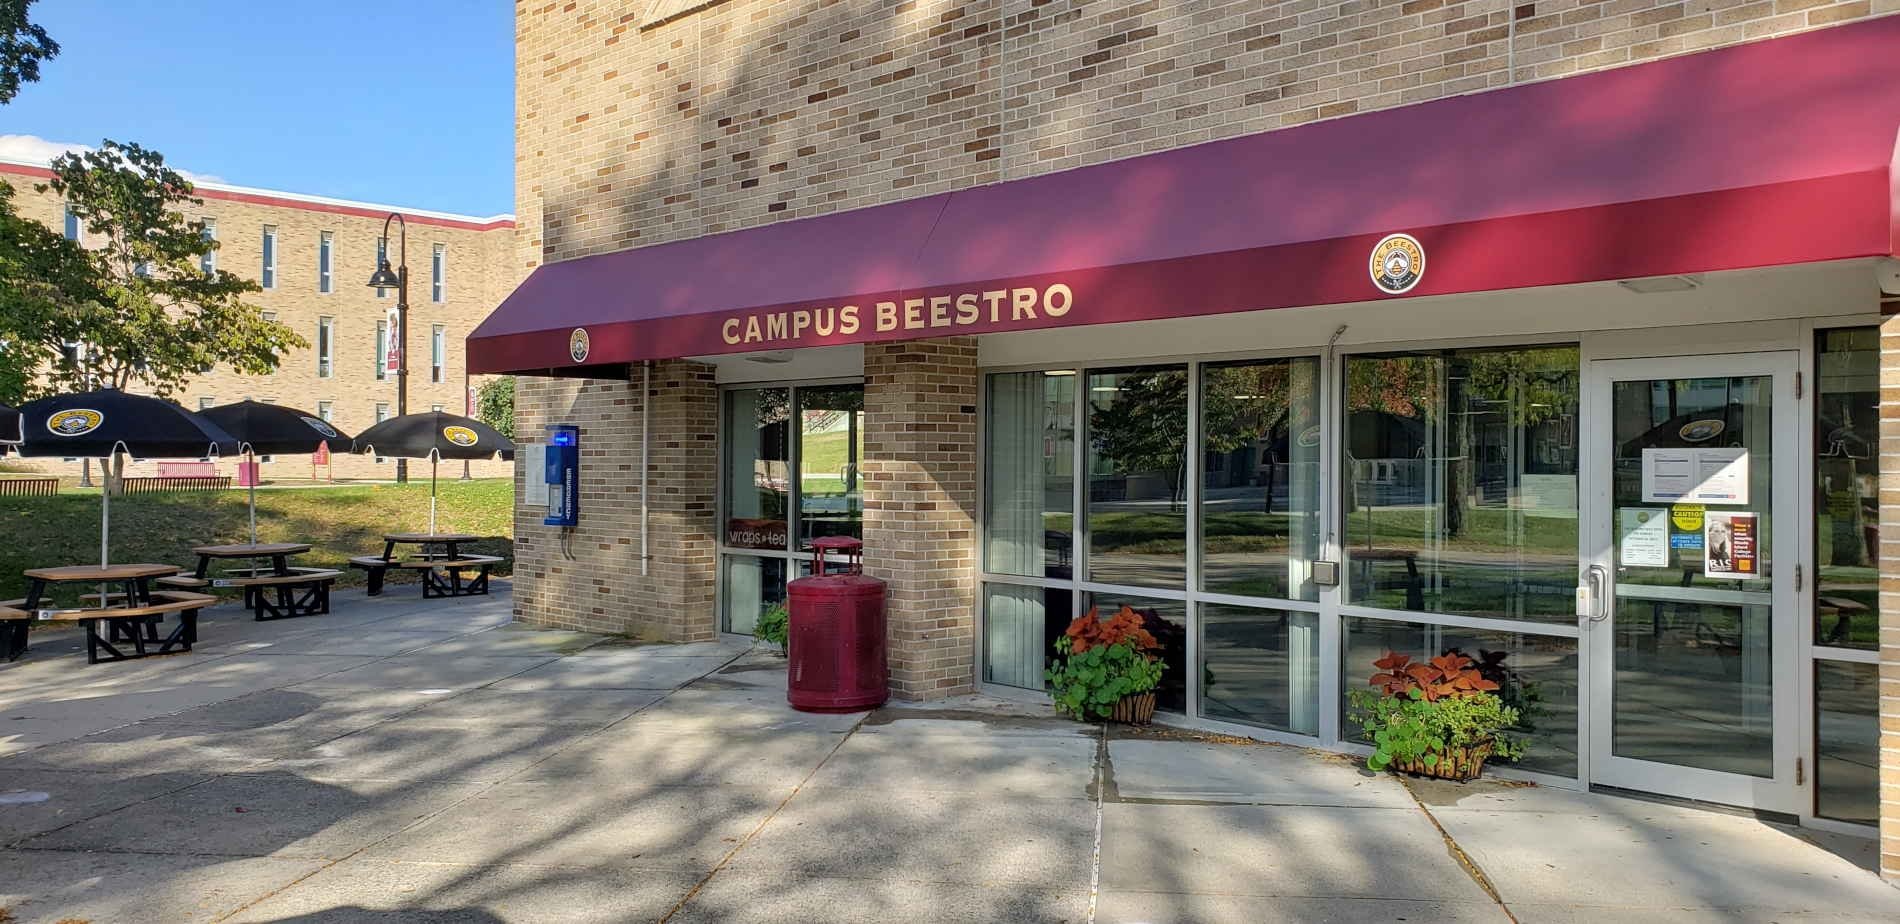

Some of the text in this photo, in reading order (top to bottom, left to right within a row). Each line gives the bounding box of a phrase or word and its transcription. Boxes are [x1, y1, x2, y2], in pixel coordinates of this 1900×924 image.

[1385, 240, 1418, 270] BEESTRO
[722, 283, 1073, 345] CAMPUS BEESTRO
[729, 528, 786, 545] wraps tea
